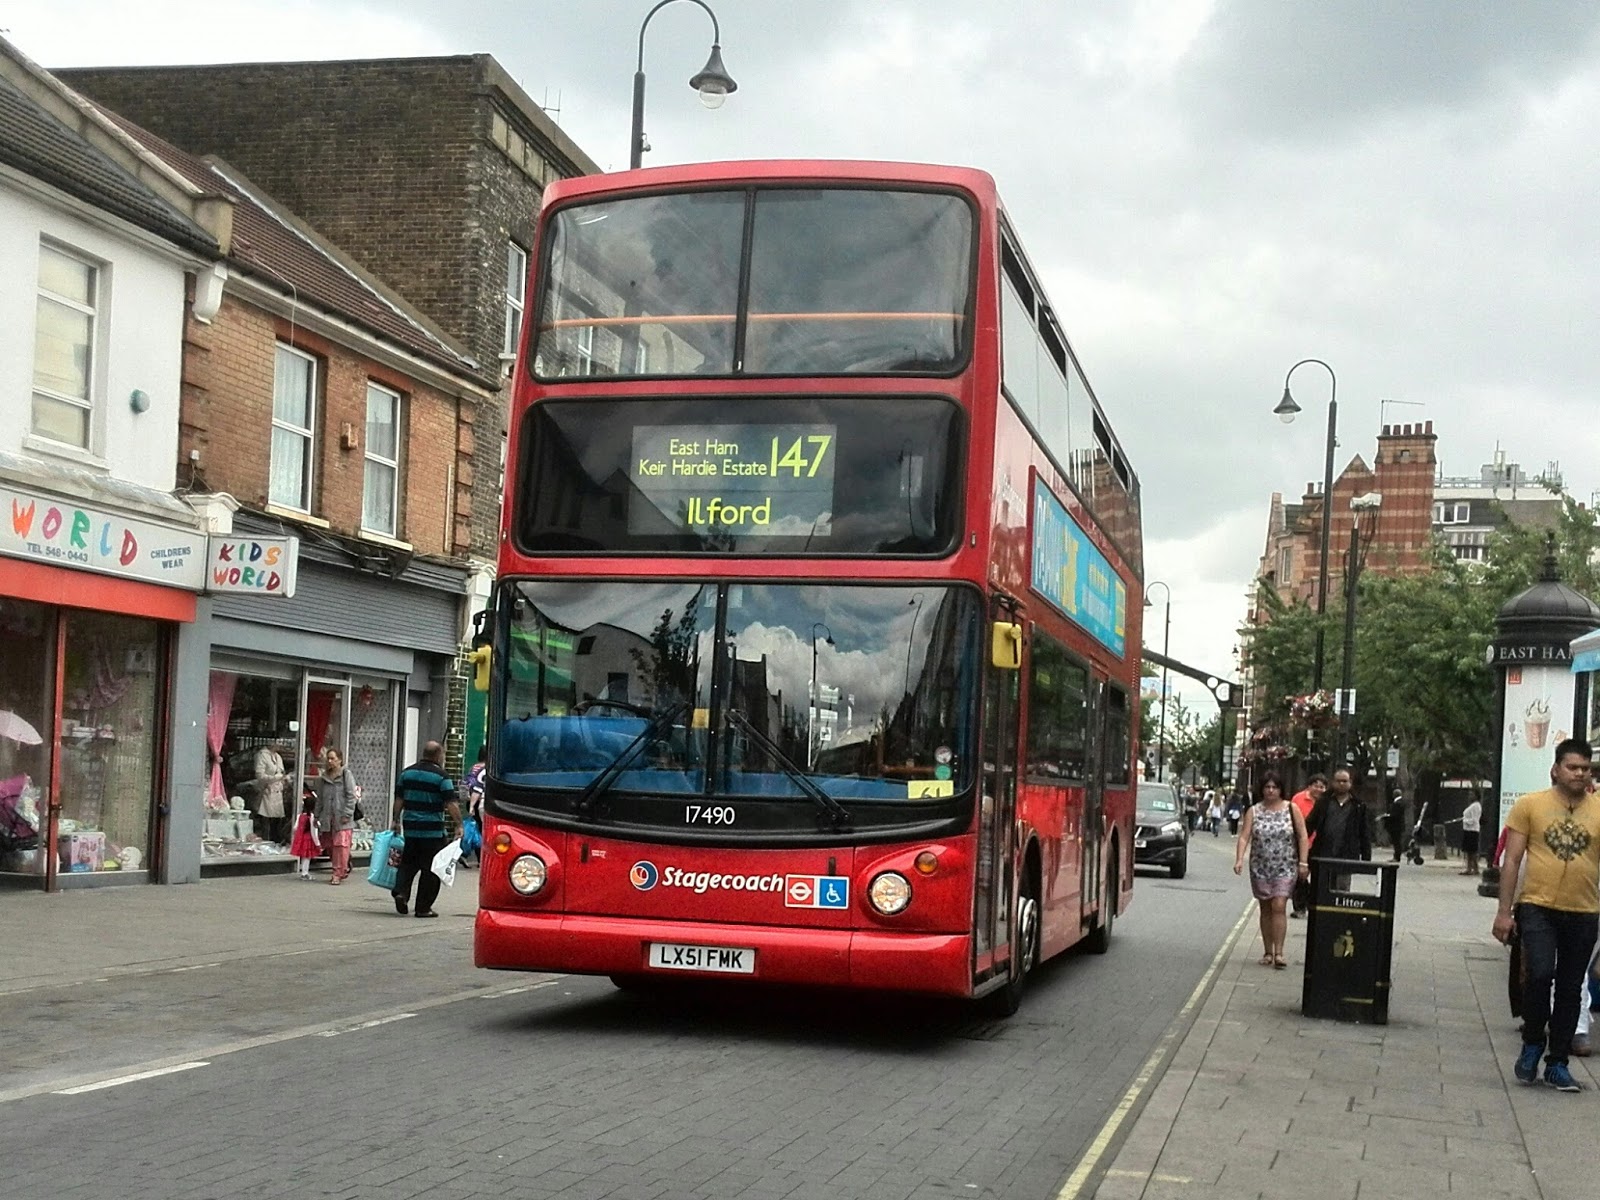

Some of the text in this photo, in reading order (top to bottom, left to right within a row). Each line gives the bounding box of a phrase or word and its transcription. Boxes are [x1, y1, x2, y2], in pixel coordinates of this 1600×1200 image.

[669, 438, 739, 456] East Ham
[769, 434, 833, 478] 147
[638, 458, 768, 476] Keir Hardie Estate
[687, 496, 772, 526] Ilford
[11, 497, 139, 567] WORLD
[27, 541, 42, 554] TEL
[150, 546, 192, 559] CHILDRENS
[218, 541, 283, 567] KIDS
[161, 558, 184, 569] WEAR
[213, 566, 281, 591] WORLD
[1499, 646, 1574, 660] EAST HA
[685, 805, 736, 825] 17490
[661, 865, 785, 894] Stagecoach
[1334, 897, 1366, 909] Litter
[660, 945, 743, 969] LX51 FMK
